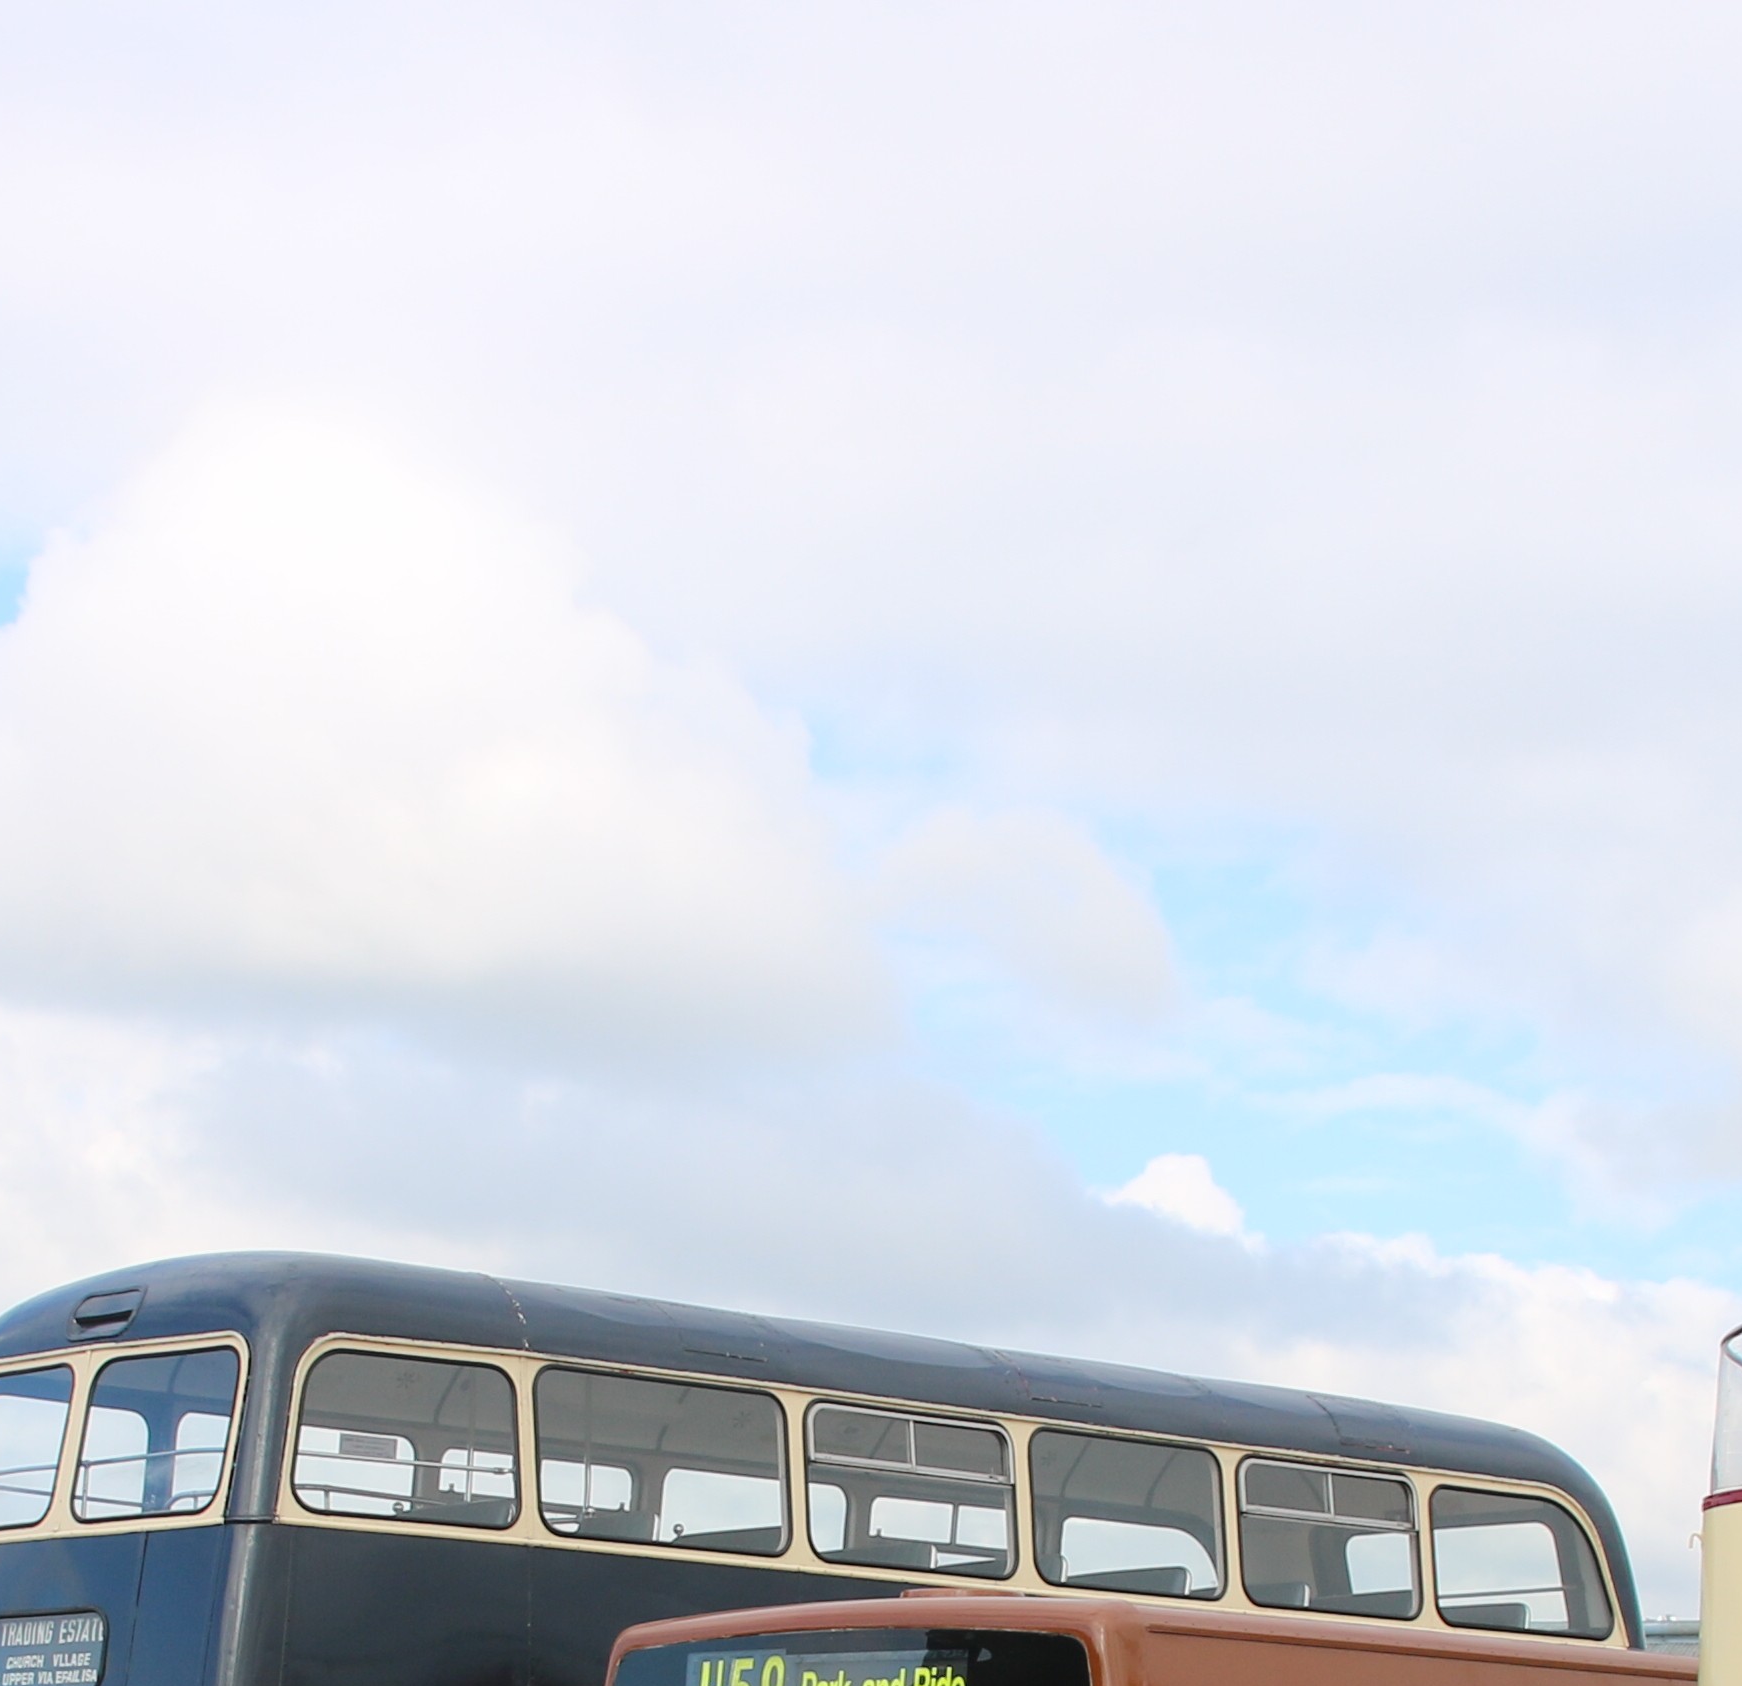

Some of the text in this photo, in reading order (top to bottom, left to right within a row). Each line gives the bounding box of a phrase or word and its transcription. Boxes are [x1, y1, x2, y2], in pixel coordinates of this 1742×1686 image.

[1, 1621, 54, 1647] TRADING
[6, 1655, 44, 1670] CHURCH
[2, 1672, 34, 1686] UPPER
[37, 1671, 53, 1685] VIA
